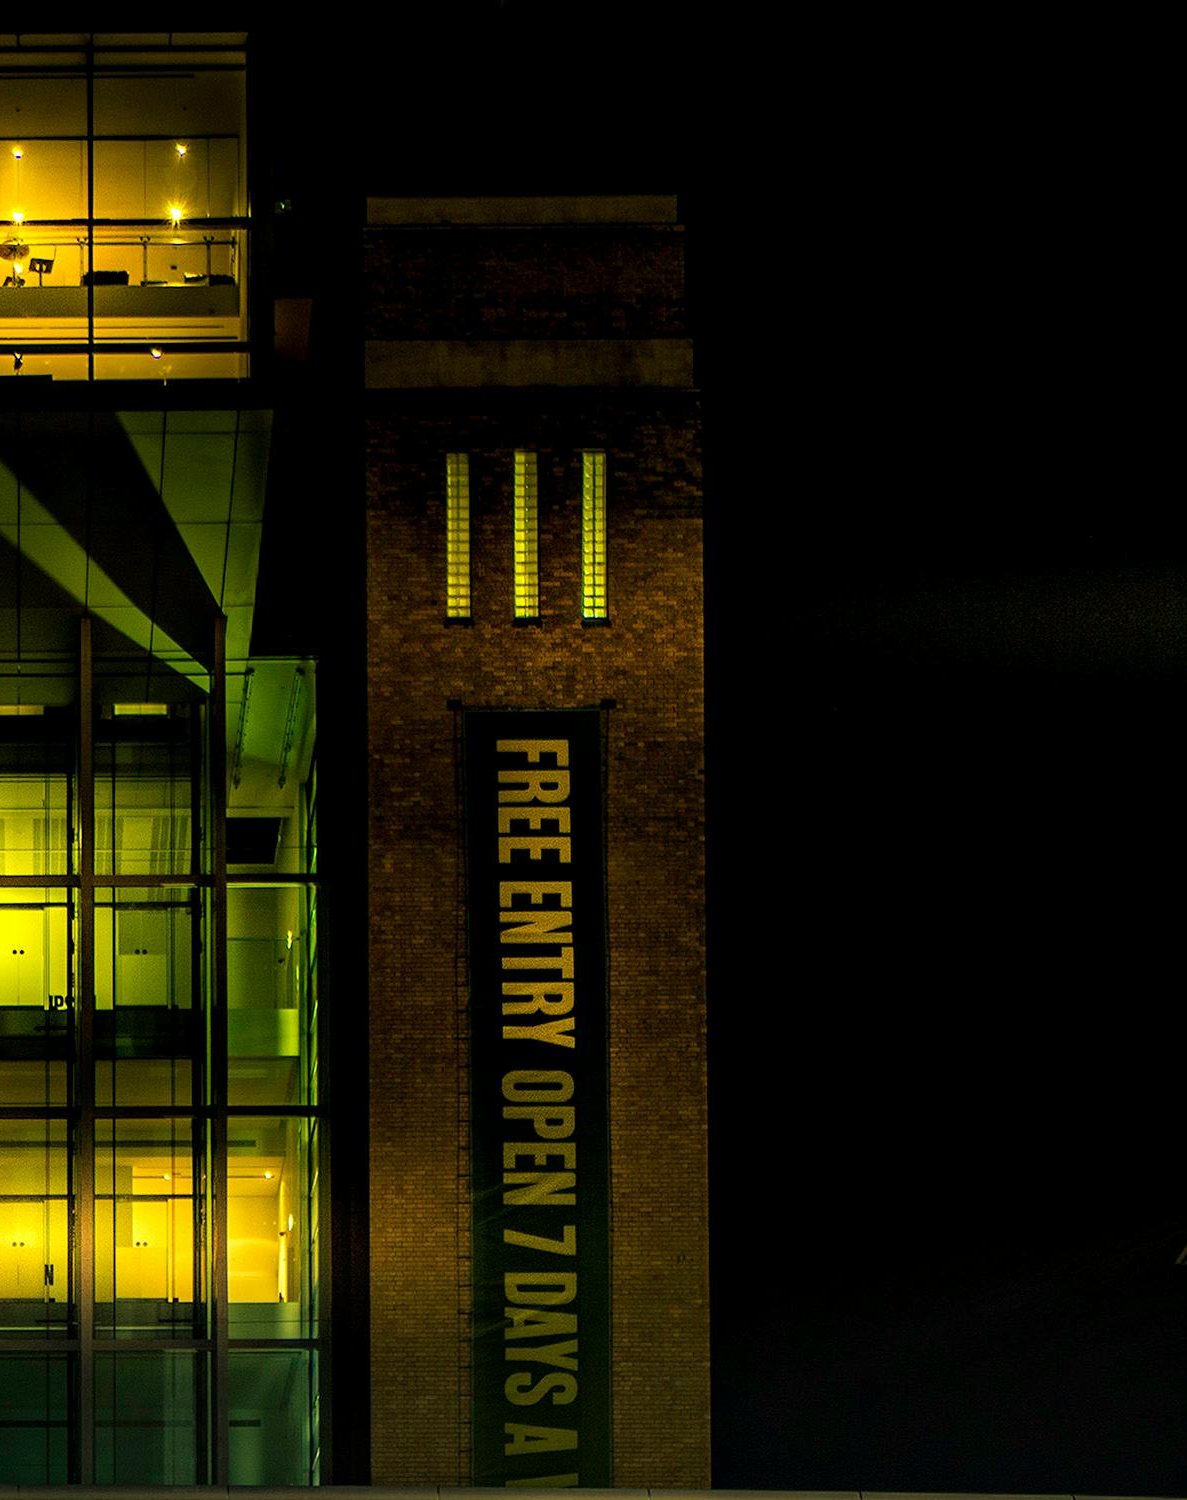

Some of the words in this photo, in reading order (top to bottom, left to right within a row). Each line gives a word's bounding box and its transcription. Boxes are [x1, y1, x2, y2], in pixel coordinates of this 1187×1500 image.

[496, 739, 570, 864] FREE
[499, 881, 576, 1049] ENTRY
[501, 1070, 577, 1205] OPEN
[503, 1225, 576, 1256] 7
[503, 1271, 578, 1406] DAYS
[504, 1423, 578, 1456] A
